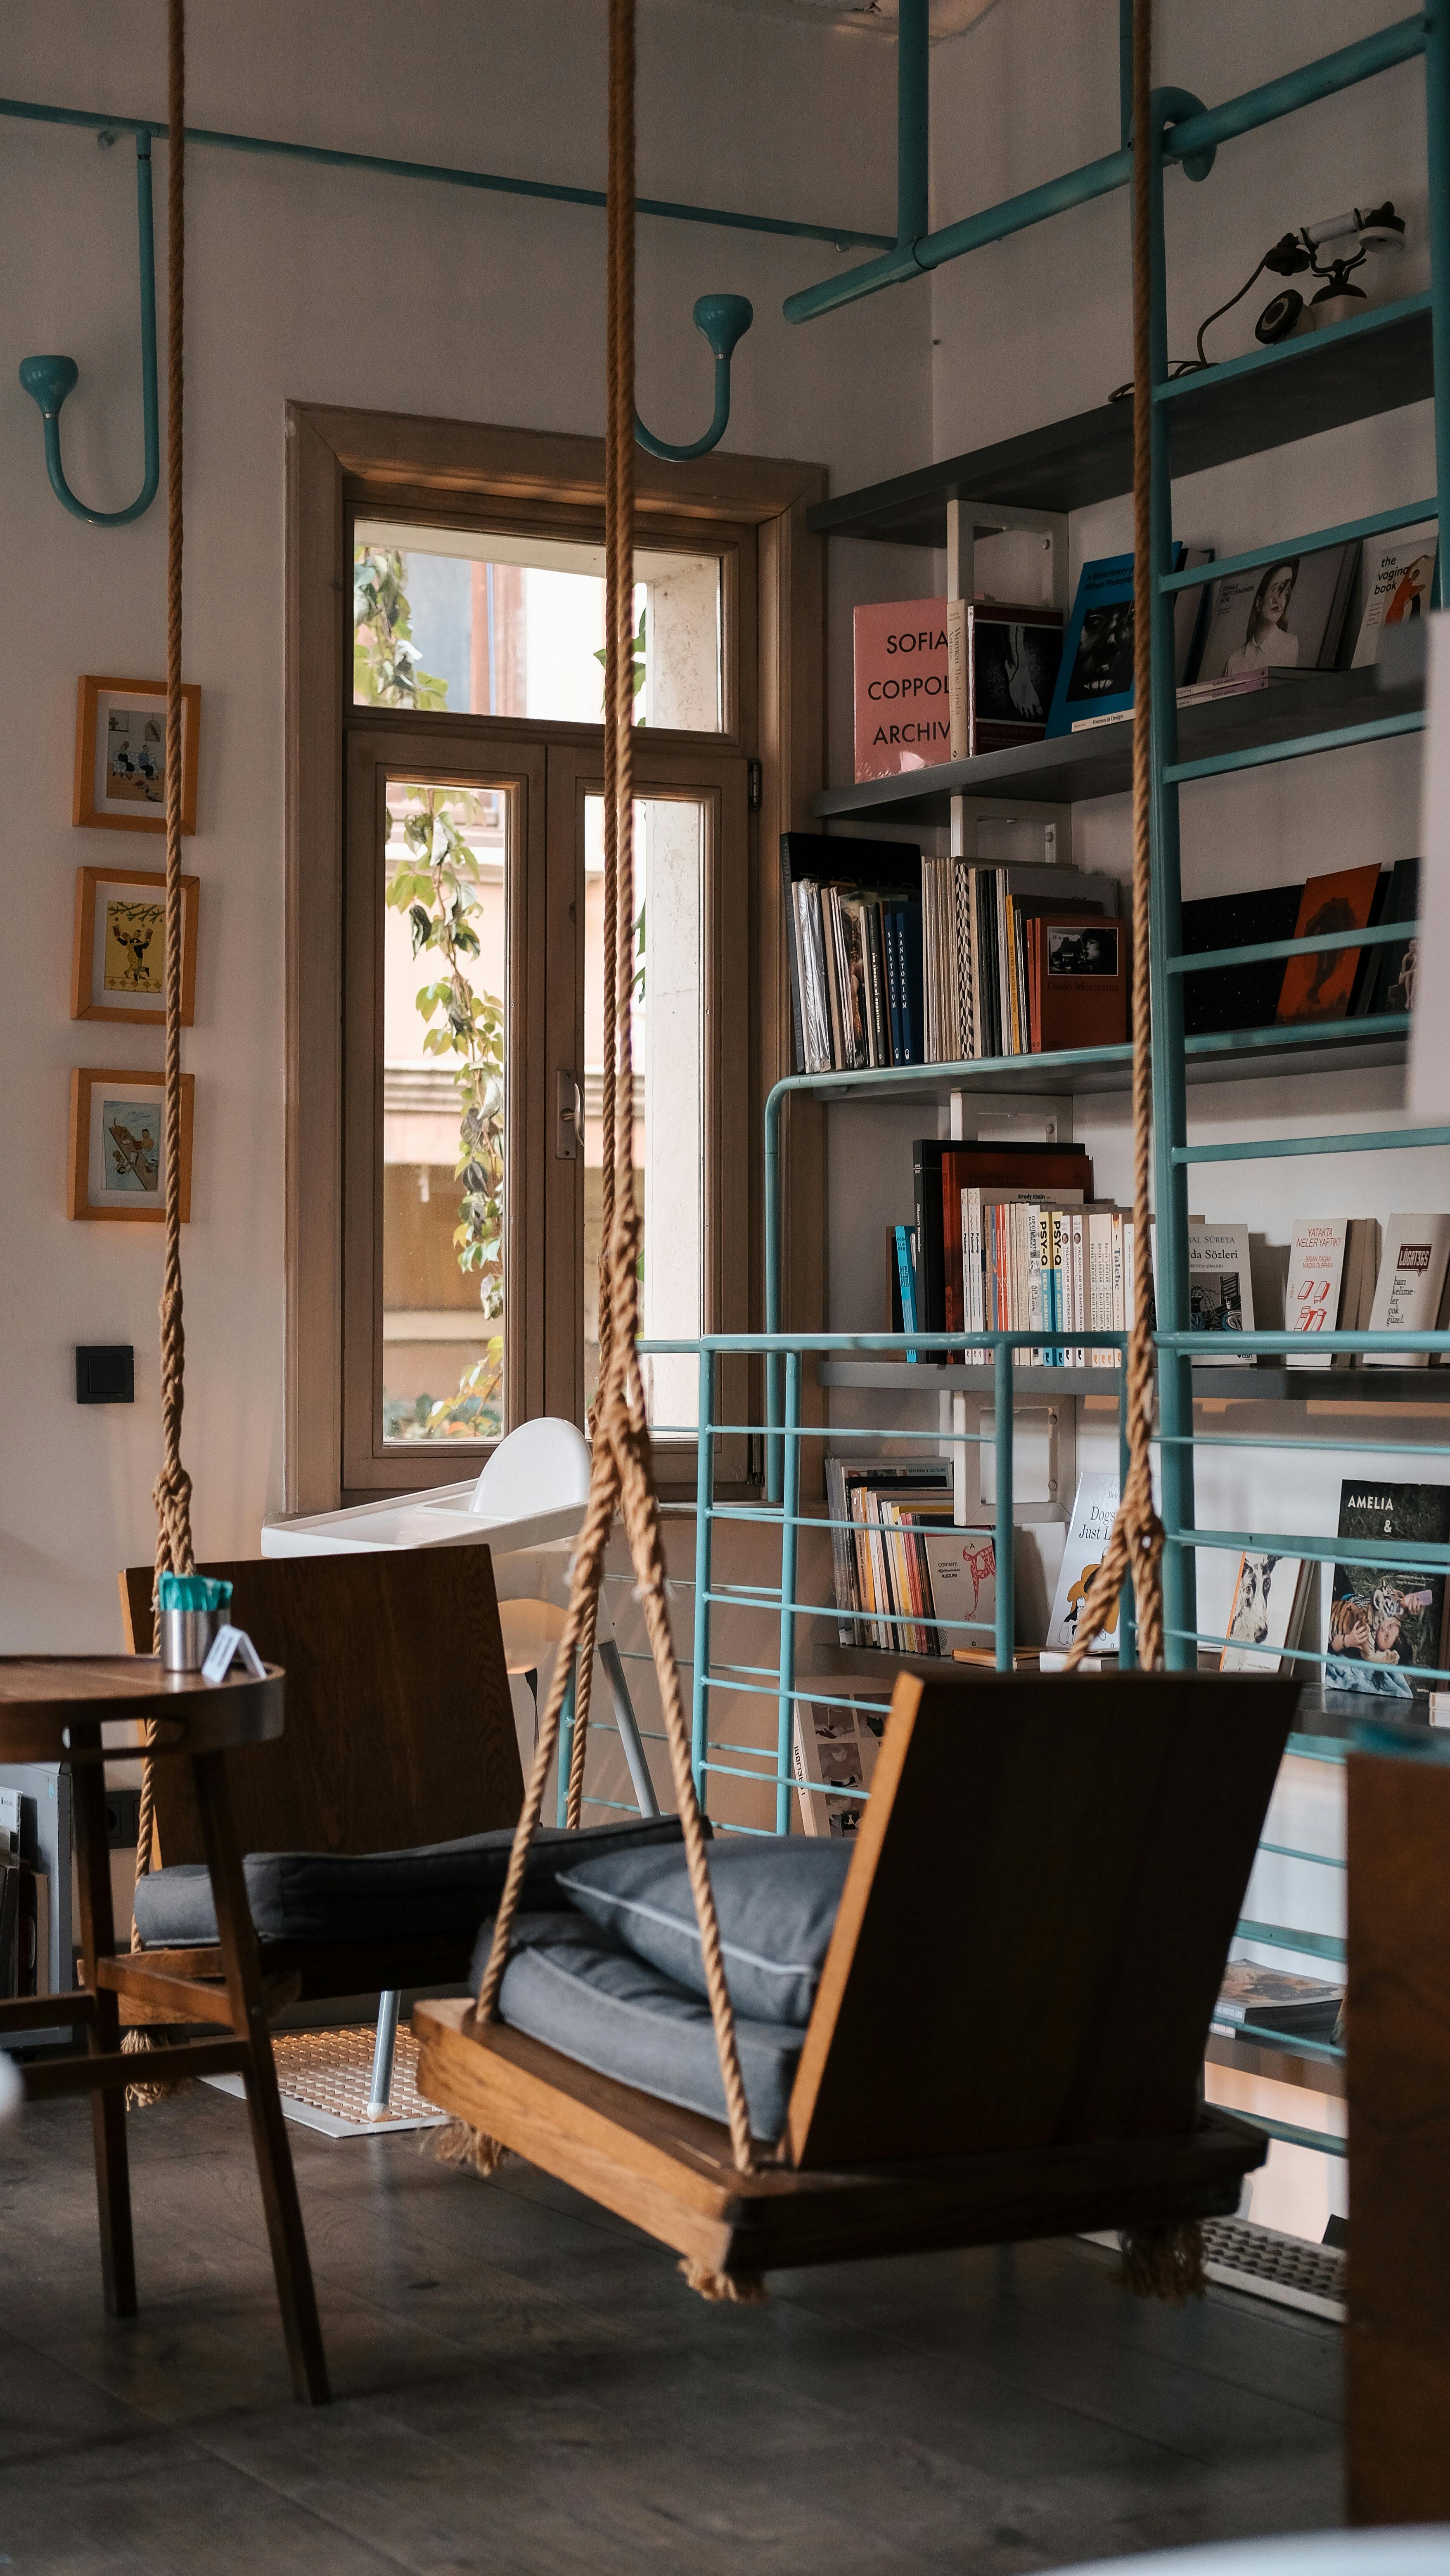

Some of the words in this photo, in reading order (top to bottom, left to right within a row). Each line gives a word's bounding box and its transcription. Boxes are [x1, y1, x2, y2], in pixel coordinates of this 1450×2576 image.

[1381, 556, 1396, 567] the
[1378, 566, 1409, 580] vagina
[1106, 576, 1134, 587] Photograp
[1374, 580, 1397, 594] book
[886, 630, 948, 654] SOFIA
[868, 676, 949, 701] COPPOL
[872, 722, 950, 745] ARCHIV
[887, 932, 896, 1009] SANATORIUM
[899, 932, 907, 1009] SANATORIUM
[1047, 981, 1073, 990] Daido
[1075, 981, 1119, 993] Moriyama
[1308, 1228, 1333, 1236] YATAKTA
[1040, 1221, 1048, 1266] PSY-Q
[1296, 1238, 1318, 1247] NELER
[1319, 1238, 1341, 1247] YAPTIK?
[1205, 1249, 1238, 1259] Sözleri
[1392, 1286, 1416, 1295] kelime-
[1390, 1295, 1399, 1305] ler
[1388, 1305, 1399, 1316] çok
[1348, 1495, 1393, 1511] AMELIA
[1090, 1506, 1116, 1525] Dogs
[1079, 1524, 1101, 1539] Just
[1384, 1520, 1392, 1533] &
[794, 1746, 805, 1790] RELIBRI
